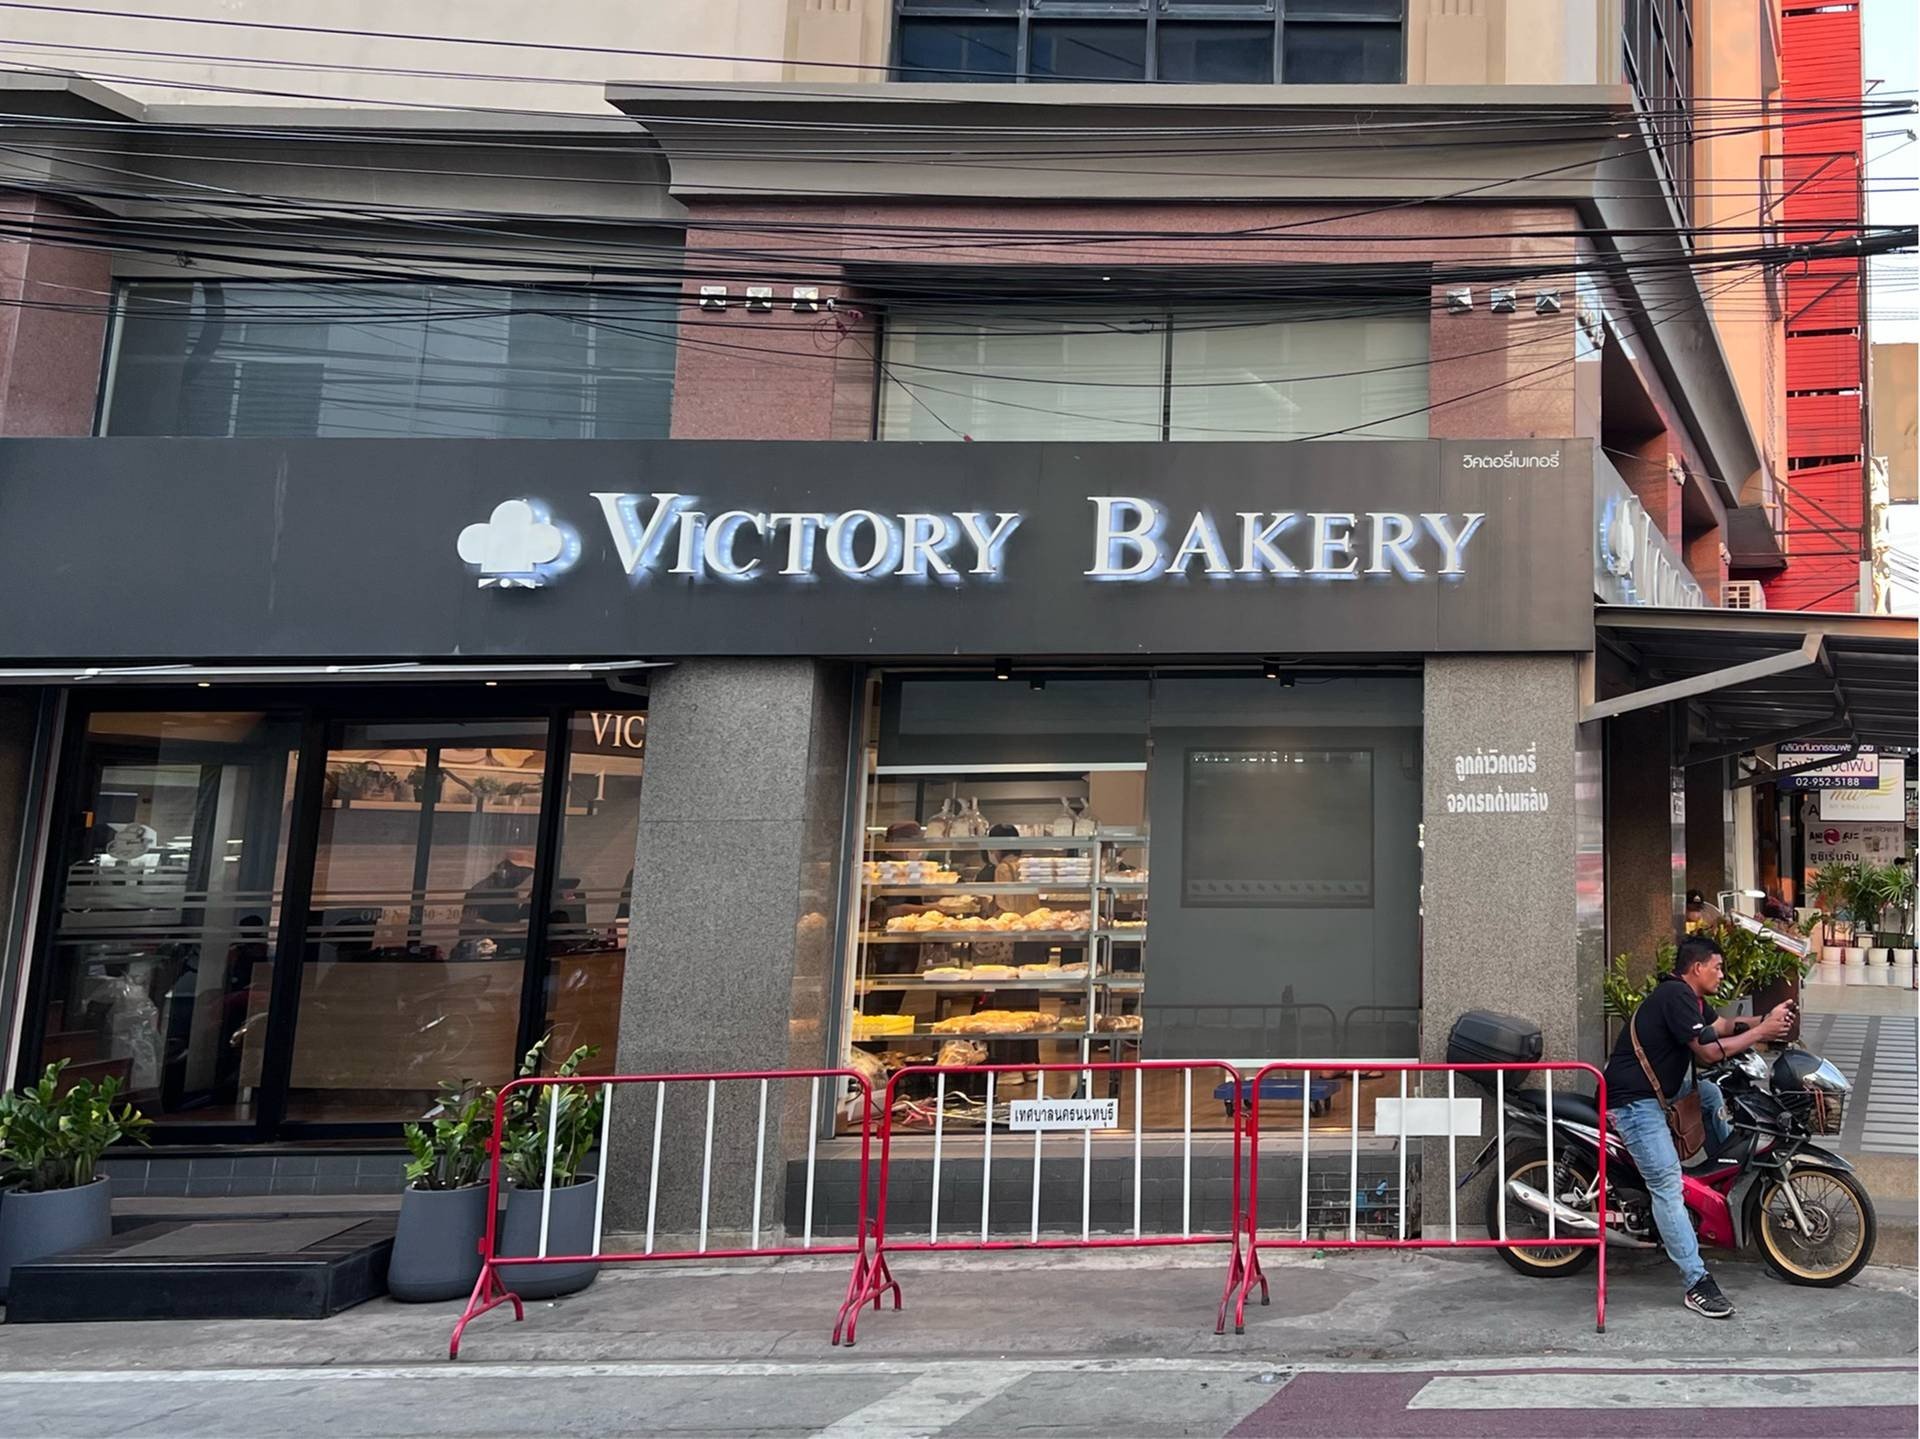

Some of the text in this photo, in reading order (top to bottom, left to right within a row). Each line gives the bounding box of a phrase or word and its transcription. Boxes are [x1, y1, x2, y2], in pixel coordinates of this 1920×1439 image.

[1463, 450, 1560, 468] วิคตอรี่เบเกอรี่
[589, 492, 1486, 576] VICTORY BAKERY
[590, 712, 645, 748] VIC
[1795, 777, 1861, 787] 02-952-5188
[1446, 785, 1549, 813] จอดรถด้านหลัง
[1014, 1102, 1114, 1127] เทศบาลนครนนทบุรี
